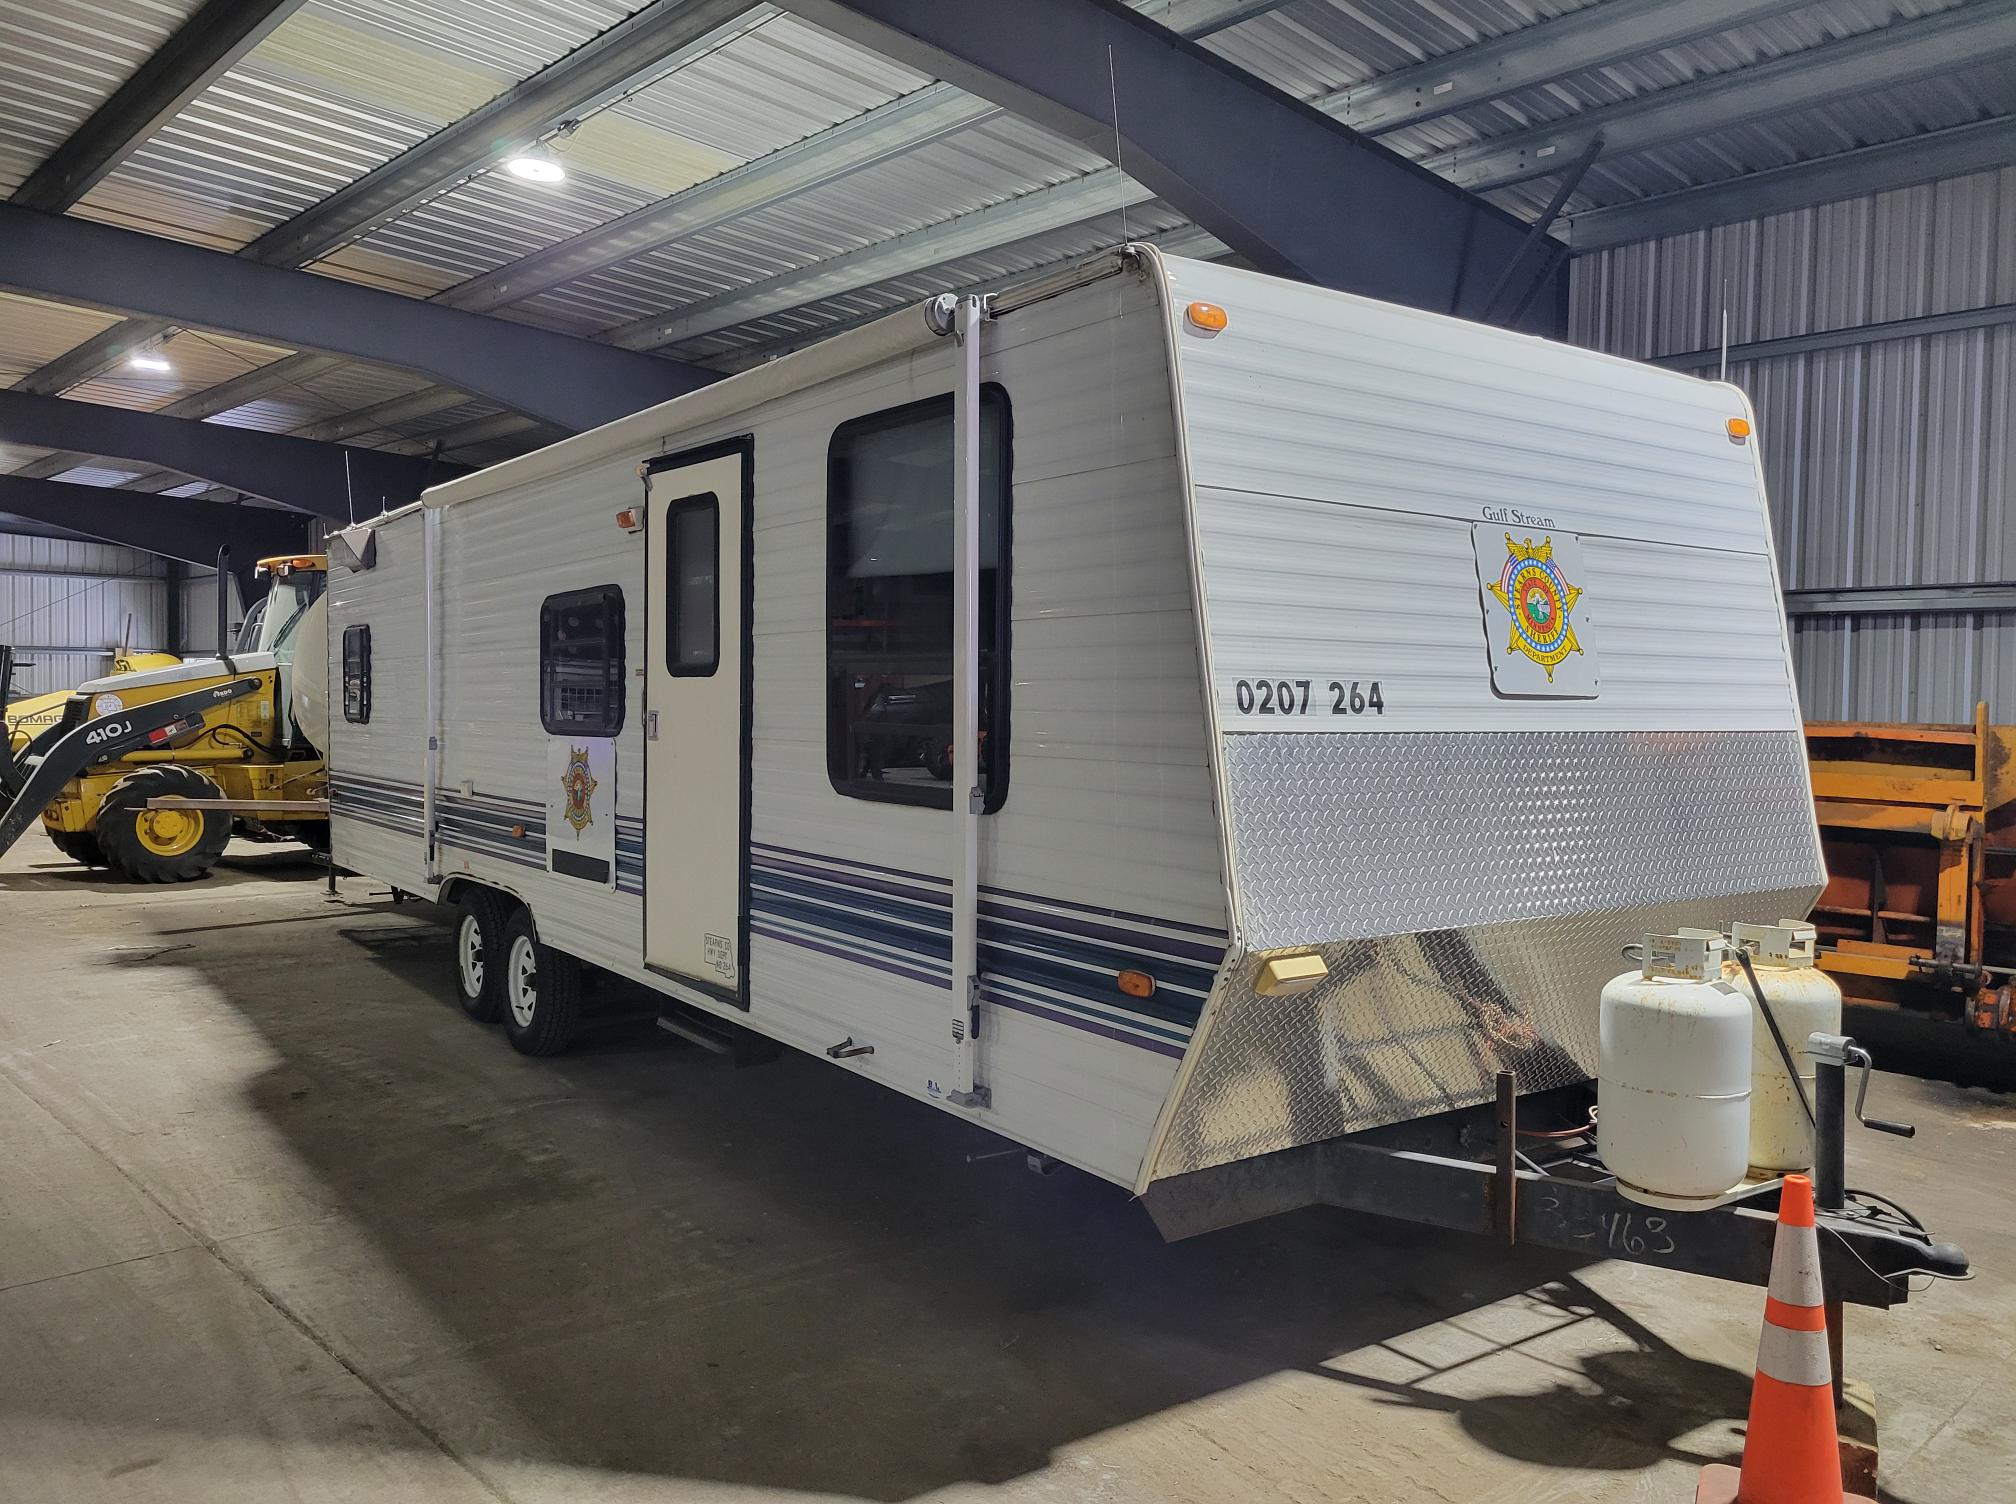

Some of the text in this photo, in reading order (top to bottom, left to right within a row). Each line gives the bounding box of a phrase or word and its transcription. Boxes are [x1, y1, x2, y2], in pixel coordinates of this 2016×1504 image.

[1482, 506, 1556, 528] Gulf Stream
[1514, 567, 1563, 614] STEARNS COUNTY
[1524, 625, 1559, 644] SHERIFF
[1523, 644, 1568, 663] DEPARTMENT
[1235, 679, 1384, 715] 0207 264
[86, 720, 132, 745] 410J
